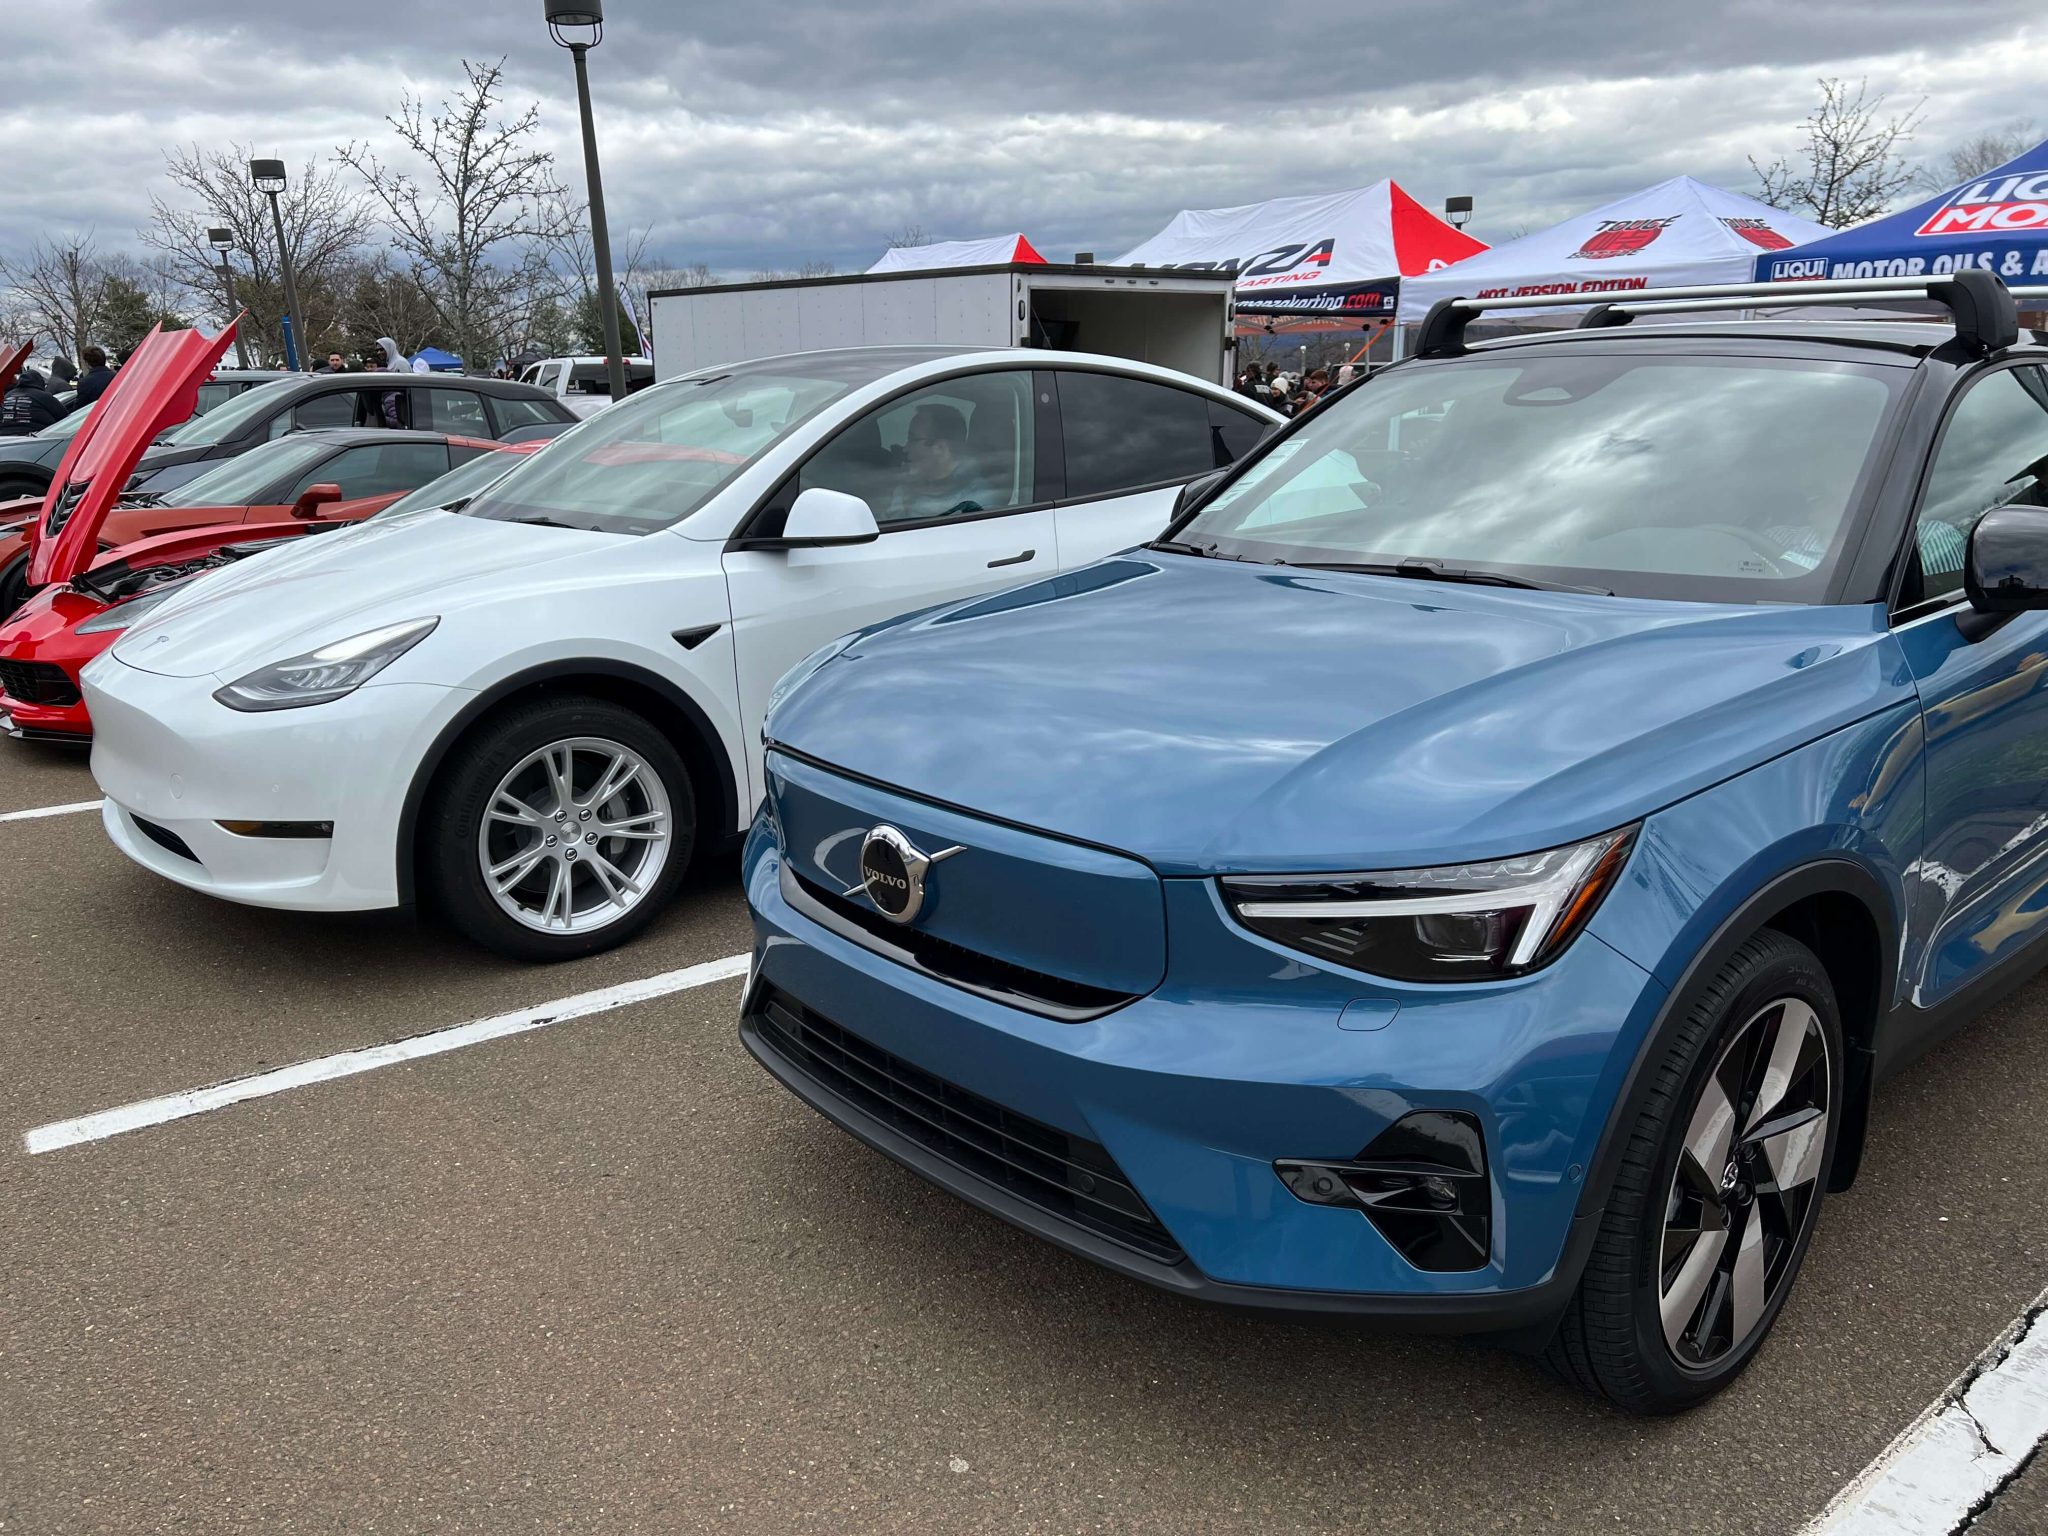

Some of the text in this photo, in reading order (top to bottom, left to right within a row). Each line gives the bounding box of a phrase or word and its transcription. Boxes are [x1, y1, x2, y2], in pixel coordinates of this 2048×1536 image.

[1929, 203, 2048, 232] MO
[1774, 260, 1825, 279] LIQUI
[1831, 257, 1926, 279] MOTOR
[2000, 250, 2024, 276] &
[1581, 277, 1648, 292] EDITION
[864, 865, 907, 890] VOLVO
